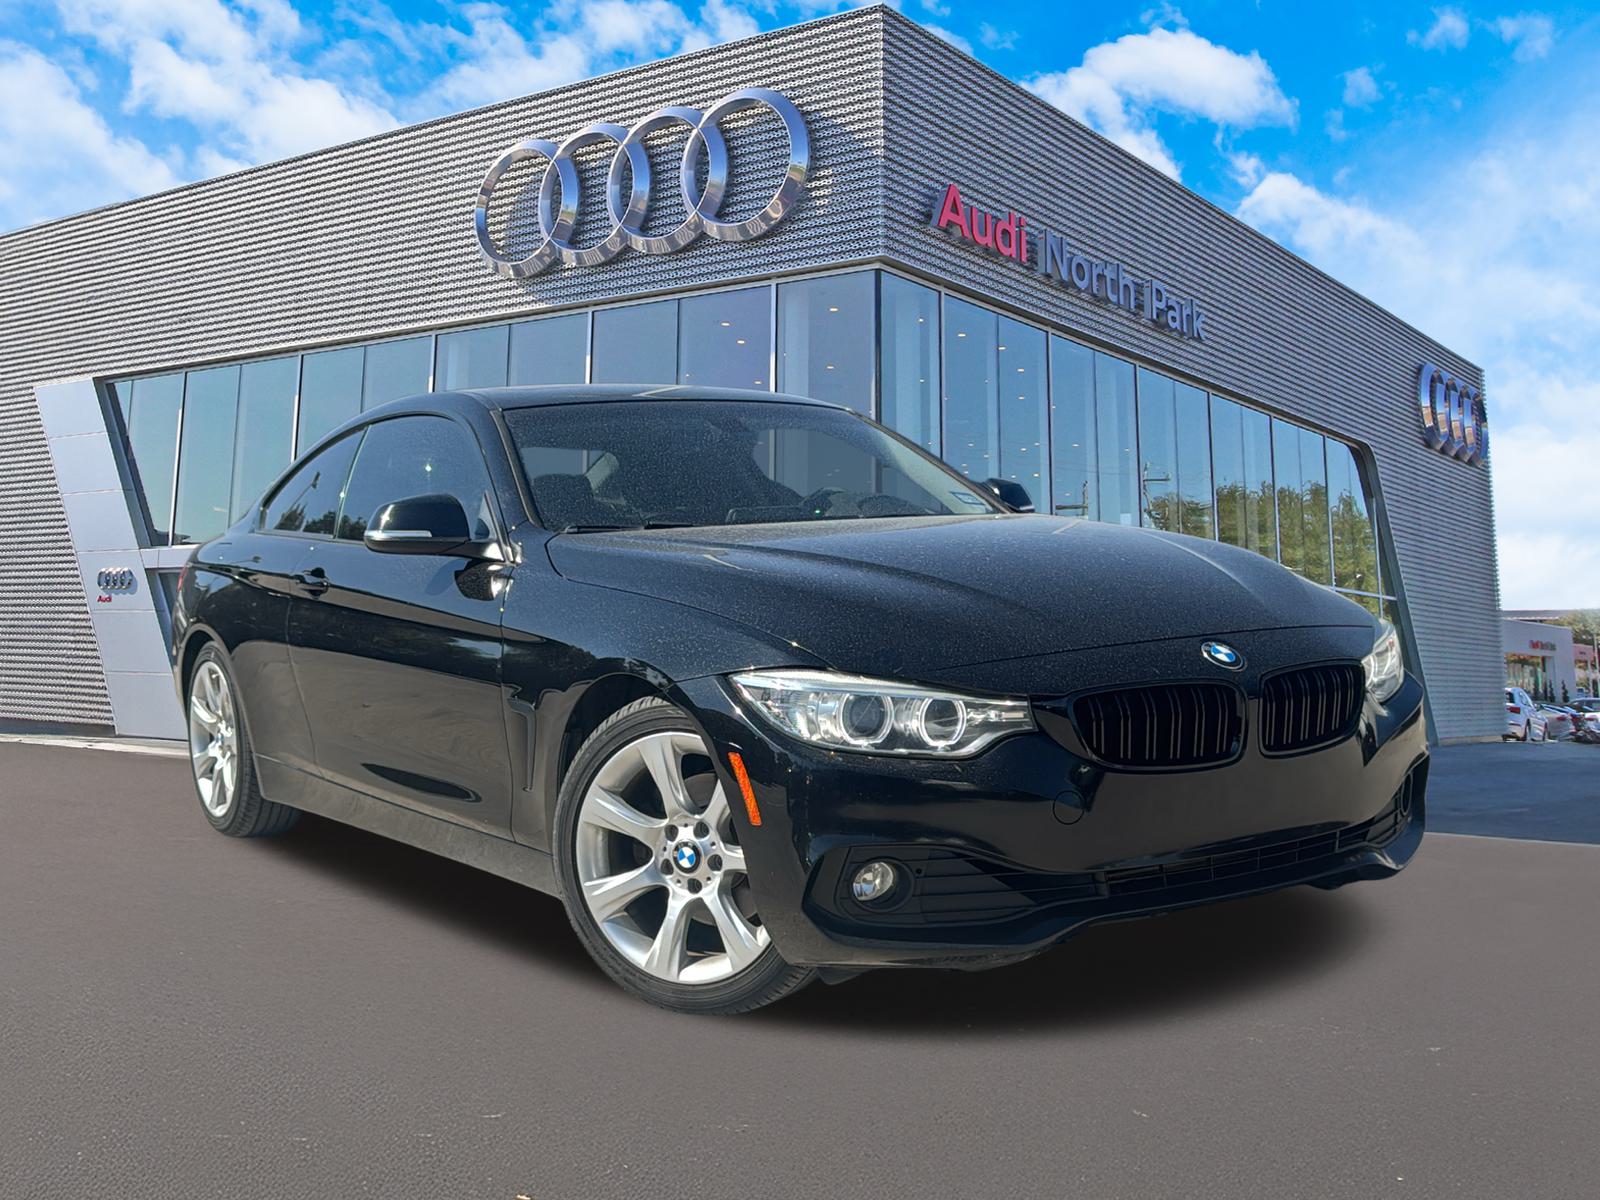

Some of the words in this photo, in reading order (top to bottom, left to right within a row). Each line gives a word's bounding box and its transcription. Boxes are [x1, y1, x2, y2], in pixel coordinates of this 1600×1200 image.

[932, 183, 1028, 263] Audi
[1038, 229, 1135, 311] North
[1144, 278, 1206, 341] Park
